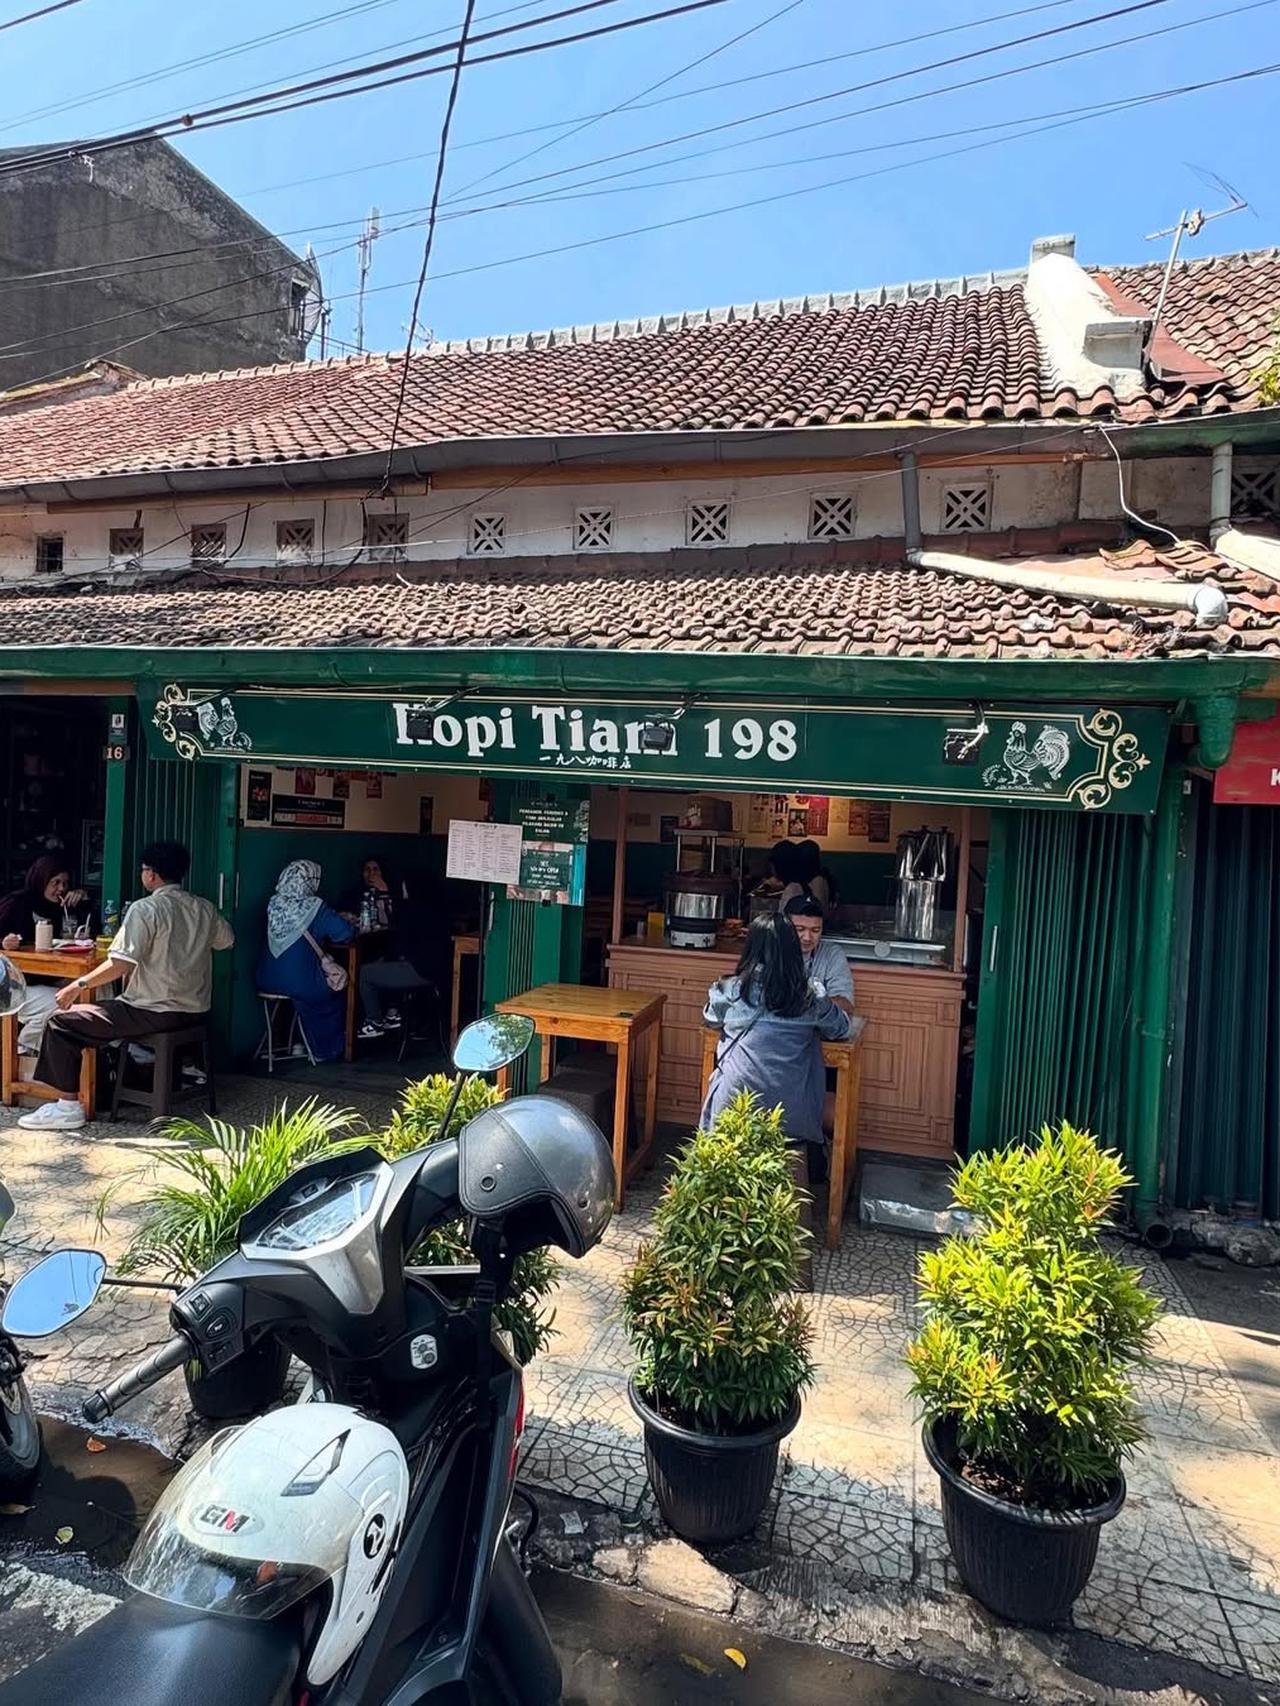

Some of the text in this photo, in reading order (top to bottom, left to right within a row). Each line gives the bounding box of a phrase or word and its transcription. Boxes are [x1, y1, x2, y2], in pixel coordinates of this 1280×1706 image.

[106, 746, 123, 760] 16
[704, 718, 797, 762] 198
[199, 1503, 250, 1533] GM
